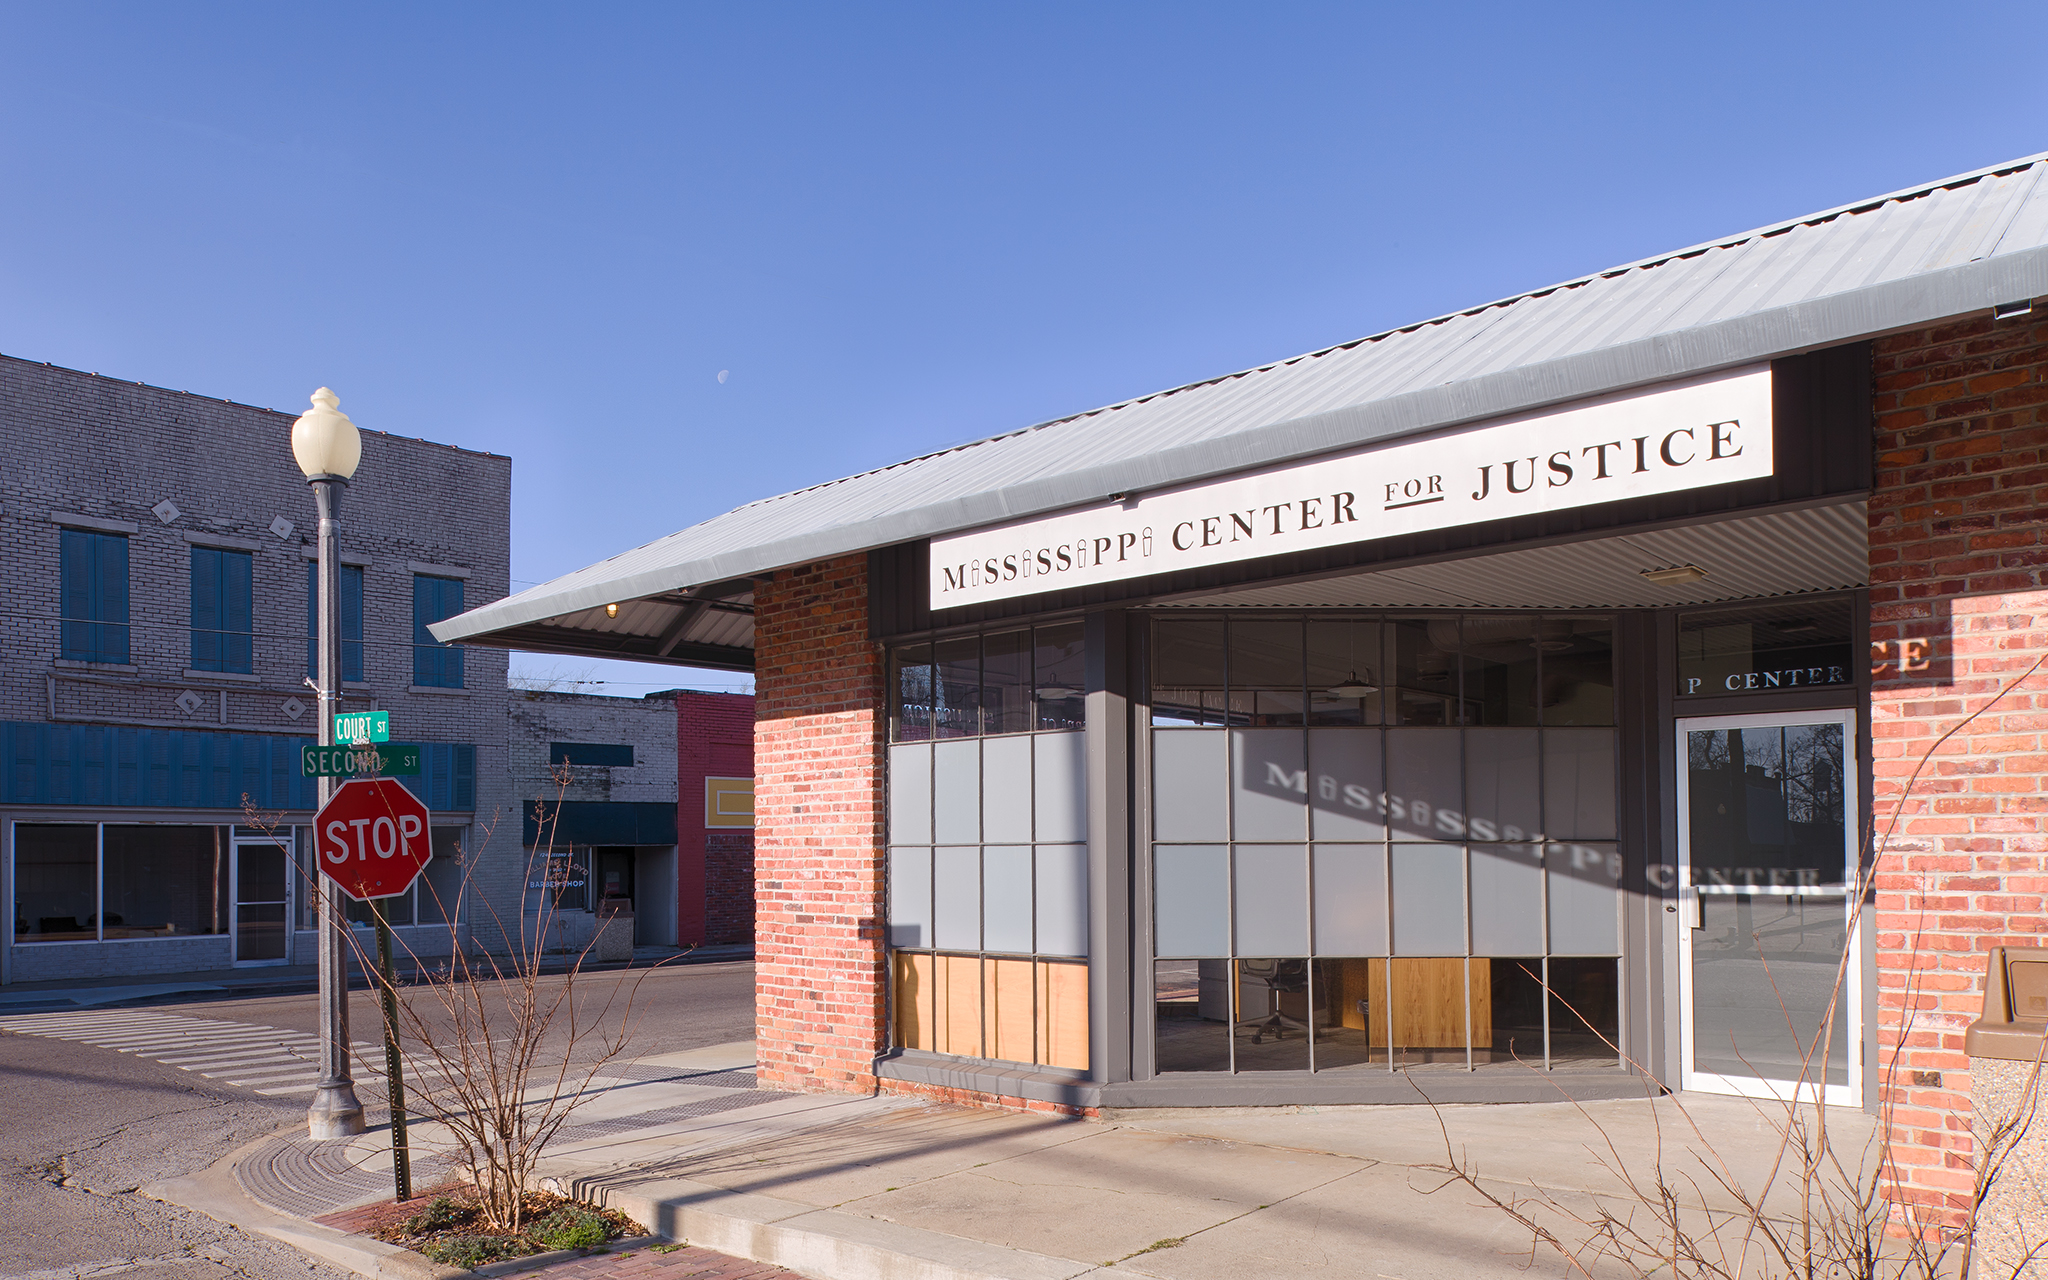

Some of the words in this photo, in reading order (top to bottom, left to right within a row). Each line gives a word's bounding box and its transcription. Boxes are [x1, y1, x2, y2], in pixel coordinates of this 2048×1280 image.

[1172, 491, 1359, 552] CENTER
[1384, 474, 1444, 502] FOR
[1471, 419, 1744, 501] JUSTICE
[1725, 665, 1846, 691] CENTER
[336, 717, 372, 740] COURT
[377, 721, 387, 733] ST
[306, 751, 381, 774] SECOND
[404, 755, 417, 767] ST
[325, 814, 422, 864] STOP
[561, 880, 584, 888] SHOP
